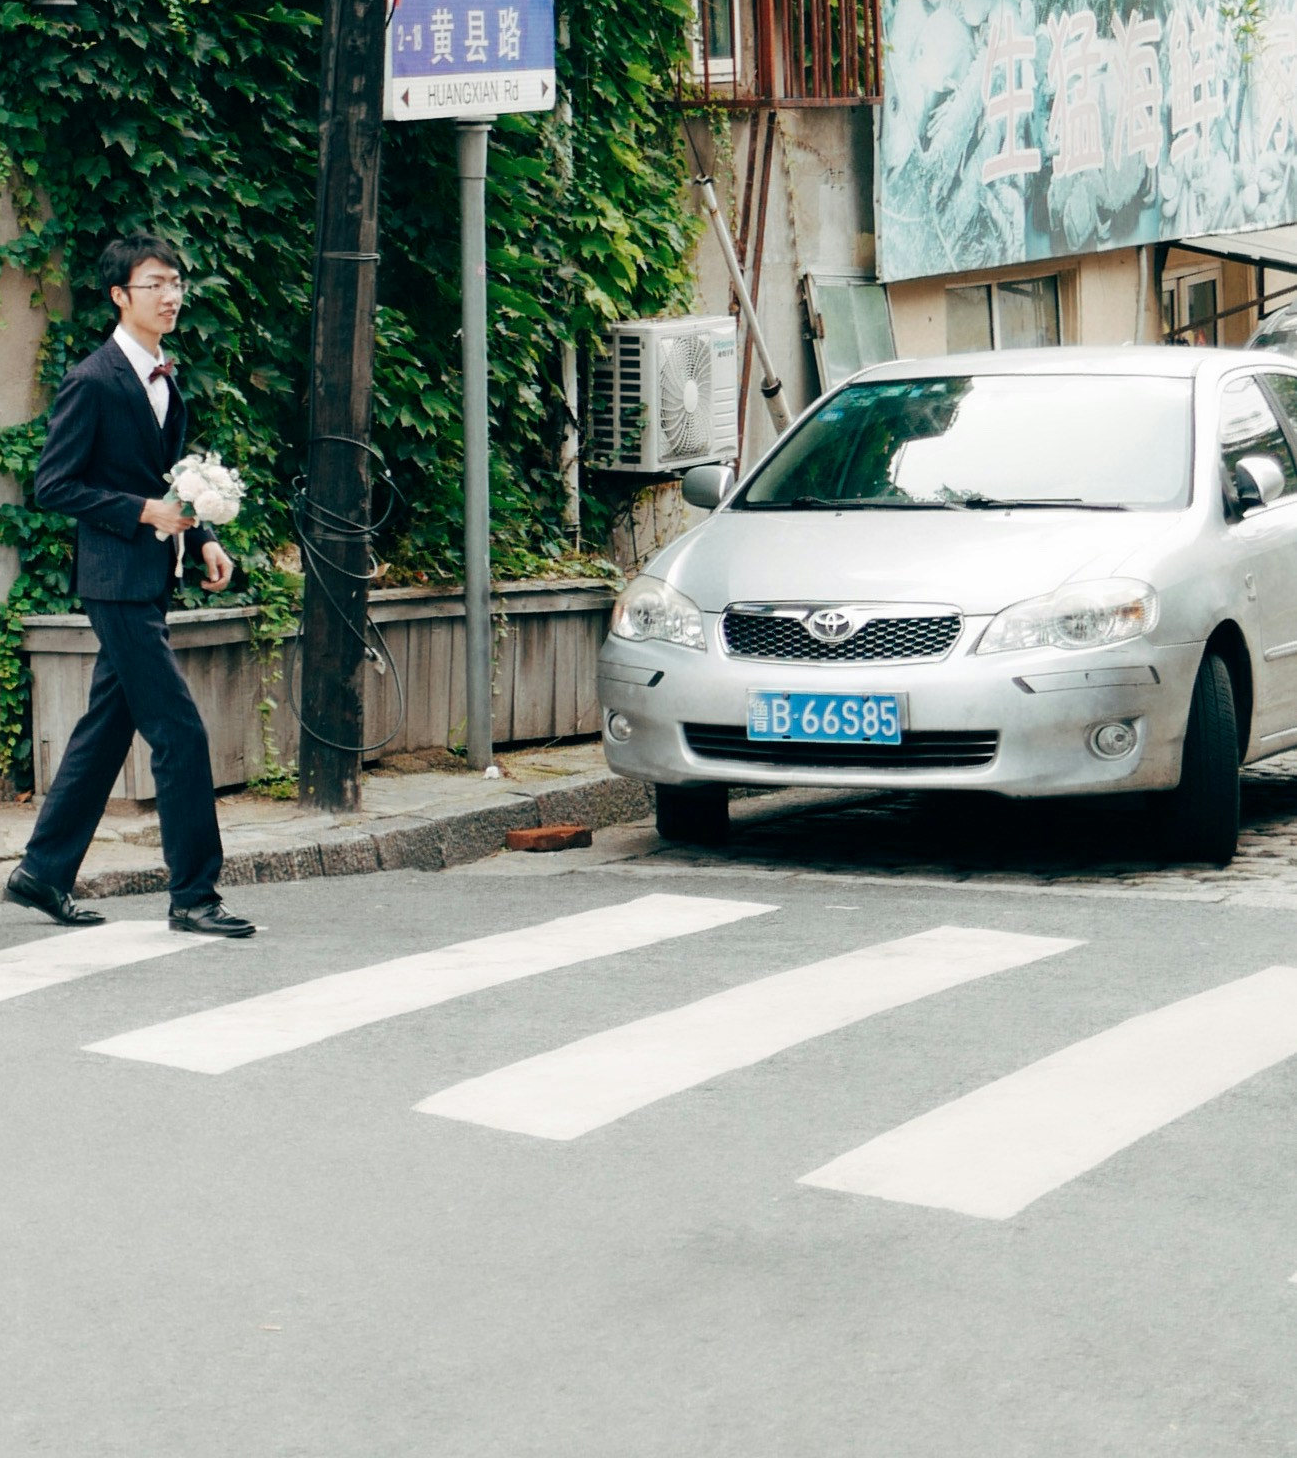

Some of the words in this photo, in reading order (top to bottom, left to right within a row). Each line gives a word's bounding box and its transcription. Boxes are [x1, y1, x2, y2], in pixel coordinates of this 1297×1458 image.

[430, 6, 521, 65] 黄县路
[427, 81, 499, 107] HUANGXIAN
[504, 79, 519, 102] Rd
[981, 7, 1225, 184] 生猛海鲜
